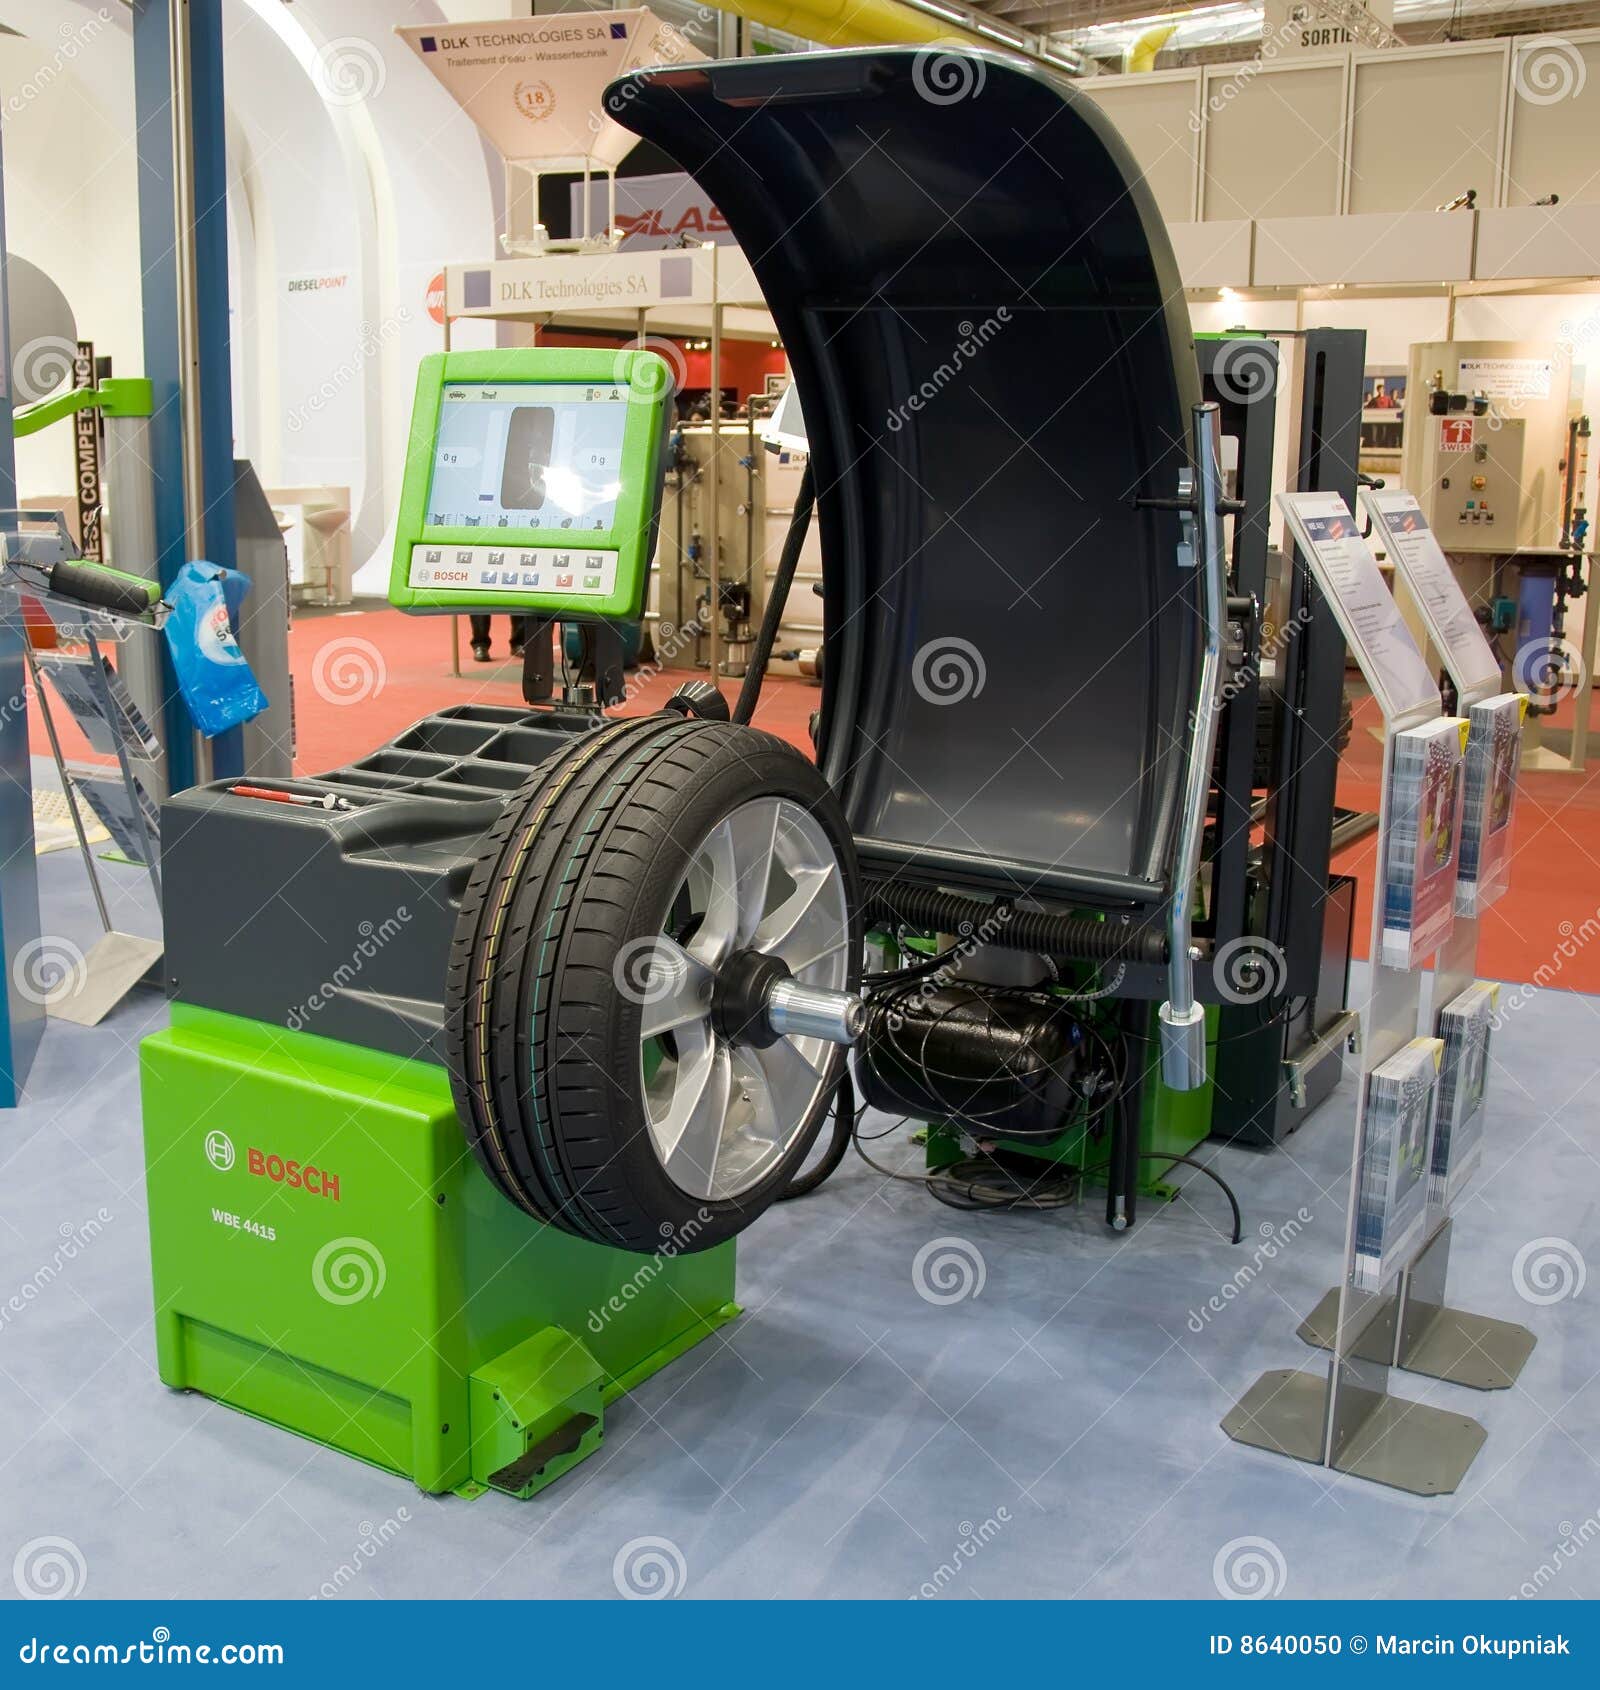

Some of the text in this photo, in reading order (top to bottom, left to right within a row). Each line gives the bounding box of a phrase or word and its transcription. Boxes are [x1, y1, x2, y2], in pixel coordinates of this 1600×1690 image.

[441, 28, 606, 50] DLK TECHNOLOGIES SA
[446, 55, 497, 67] Traitement
[535, 48, 609, 62] Wassertechnik
[501, 274, 649, 302] DLK Technologies SA
[74, 345, 98, 504] COMPETNCE
[433, 571, 469, 582] BOSCH
[247, 1147, 341, 1202] BOSCH
[211, 1207, 276, 1242] WBE 4415
